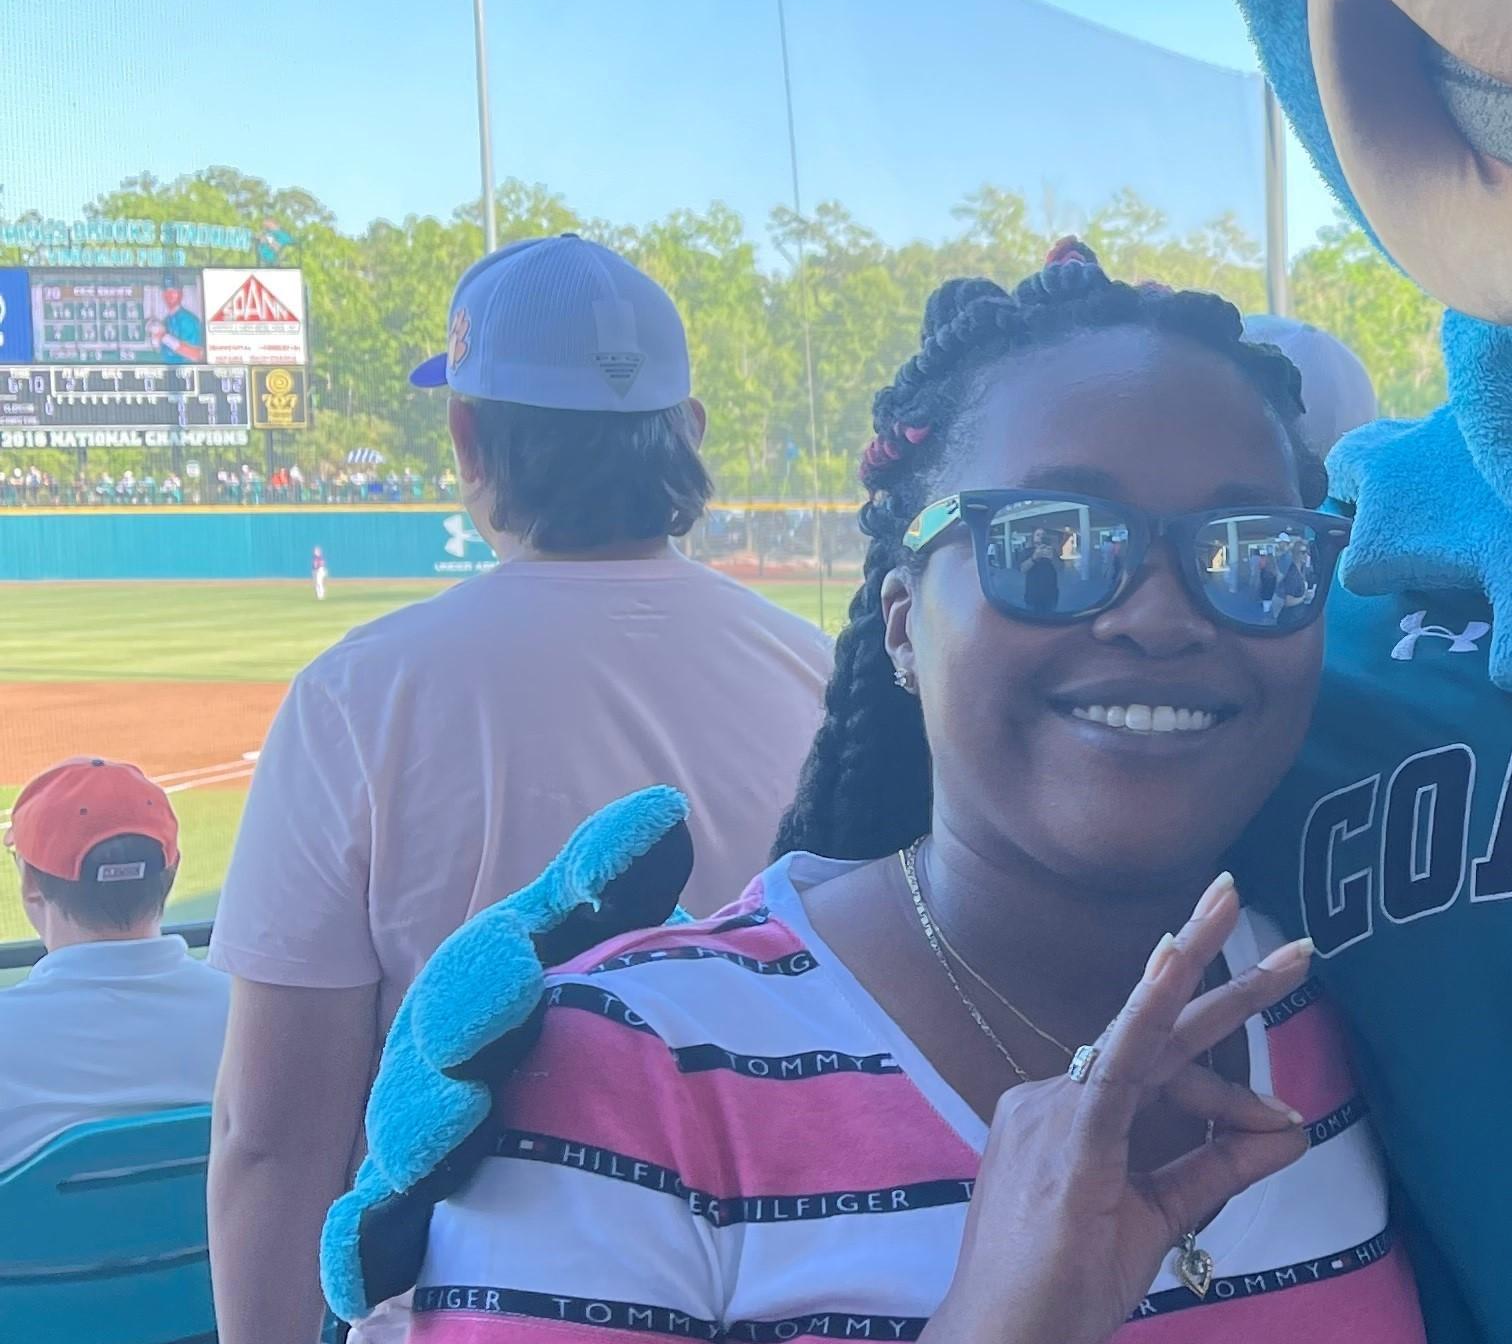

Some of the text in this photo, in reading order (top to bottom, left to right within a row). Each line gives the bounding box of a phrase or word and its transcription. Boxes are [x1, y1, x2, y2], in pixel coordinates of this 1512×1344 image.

[50, 430, 142, 448] NATIONAL
[145, 430, 249, 447] CHAMPIONS
[1215, 1260, 1320, 1299] OMMY
[745, 1313, 917, 1340] TOMMY
